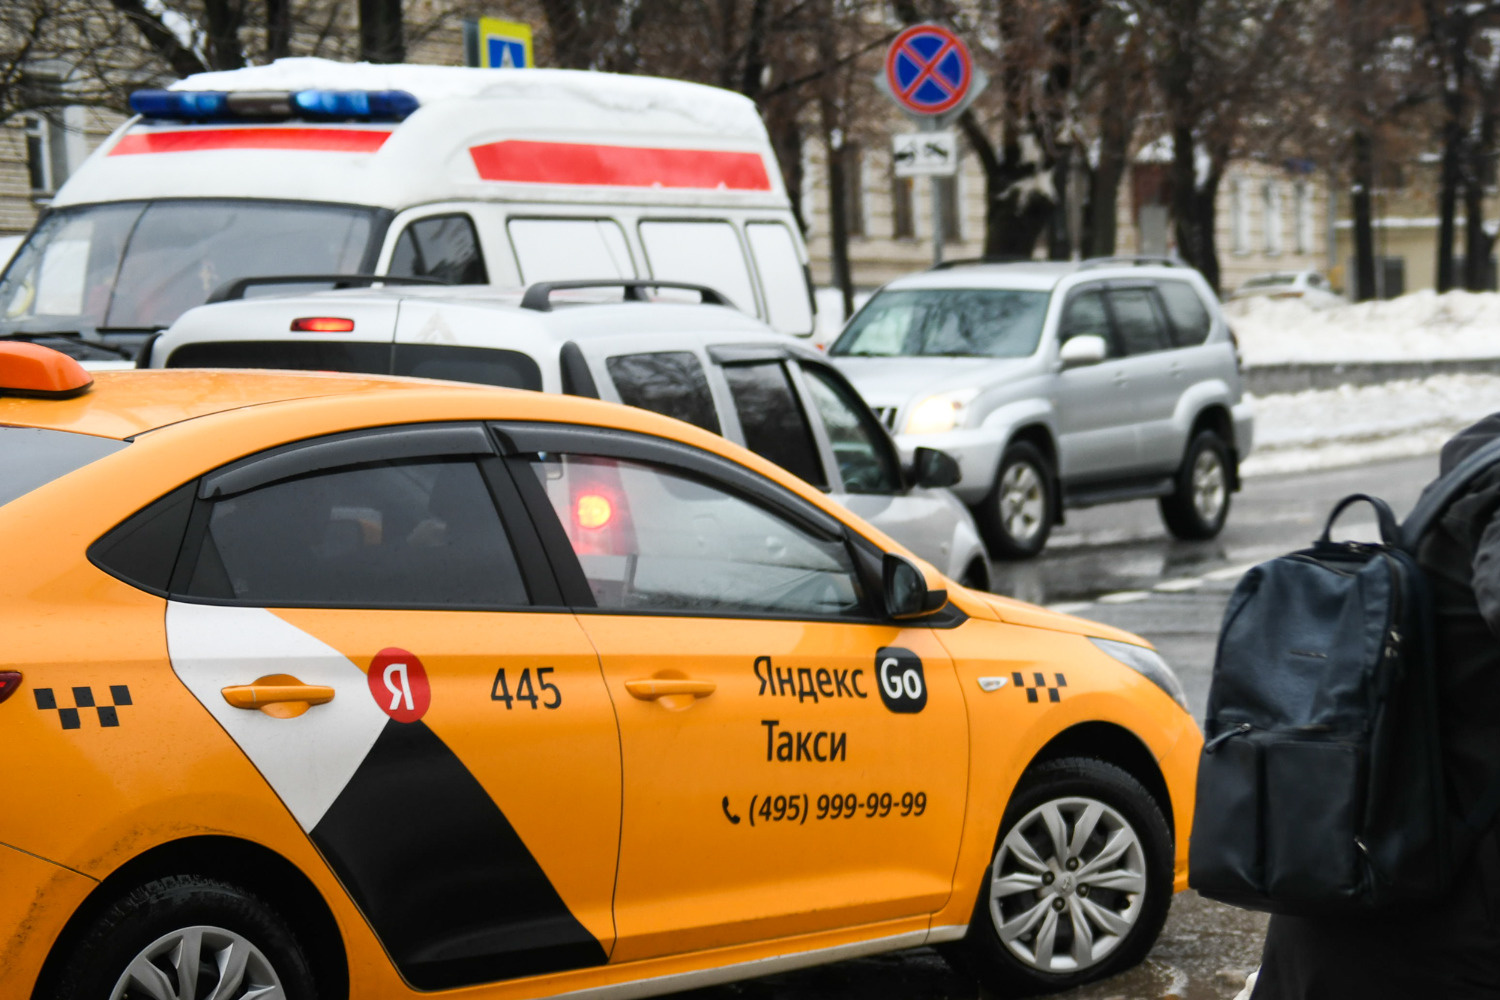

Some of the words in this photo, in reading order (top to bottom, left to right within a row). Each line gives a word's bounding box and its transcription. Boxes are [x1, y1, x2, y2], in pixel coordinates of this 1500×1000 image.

[383, 663, 415, 710] Я
[490, 667, 562, 710] 445
[753, 656, 868, 703] Яндекс
[880, 657, 922, 700] Go
[761, 720, 847, 762] Такси
[749, 794, 809, 827] (495)
[816, 792, 927, 820] 999-99-99
